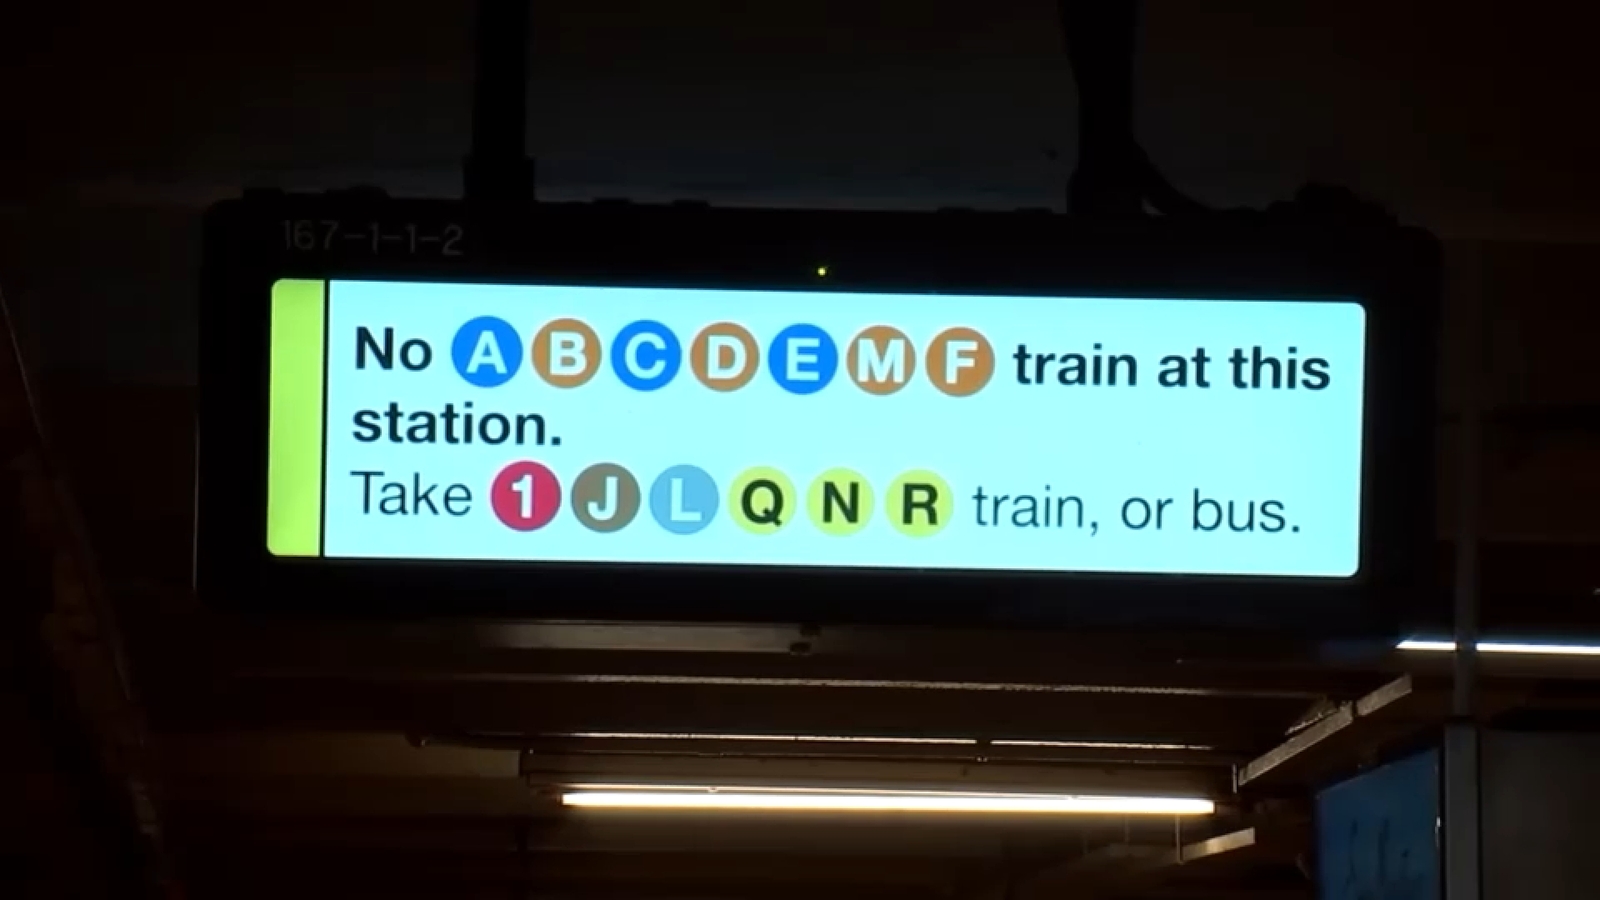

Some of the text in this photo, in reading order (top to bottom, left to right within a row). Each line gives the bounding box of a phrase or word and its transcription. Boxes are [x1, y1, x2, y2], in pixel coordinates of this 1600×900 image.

[281, 220, 464, 256] 167-1-1-2
[354, 326, 1331, 391] No A B C D E M F train at this
[351, 402, 562, 446] station.
[350, 471, 1300, 537] Take 1 J L Q N R train, or bus.
